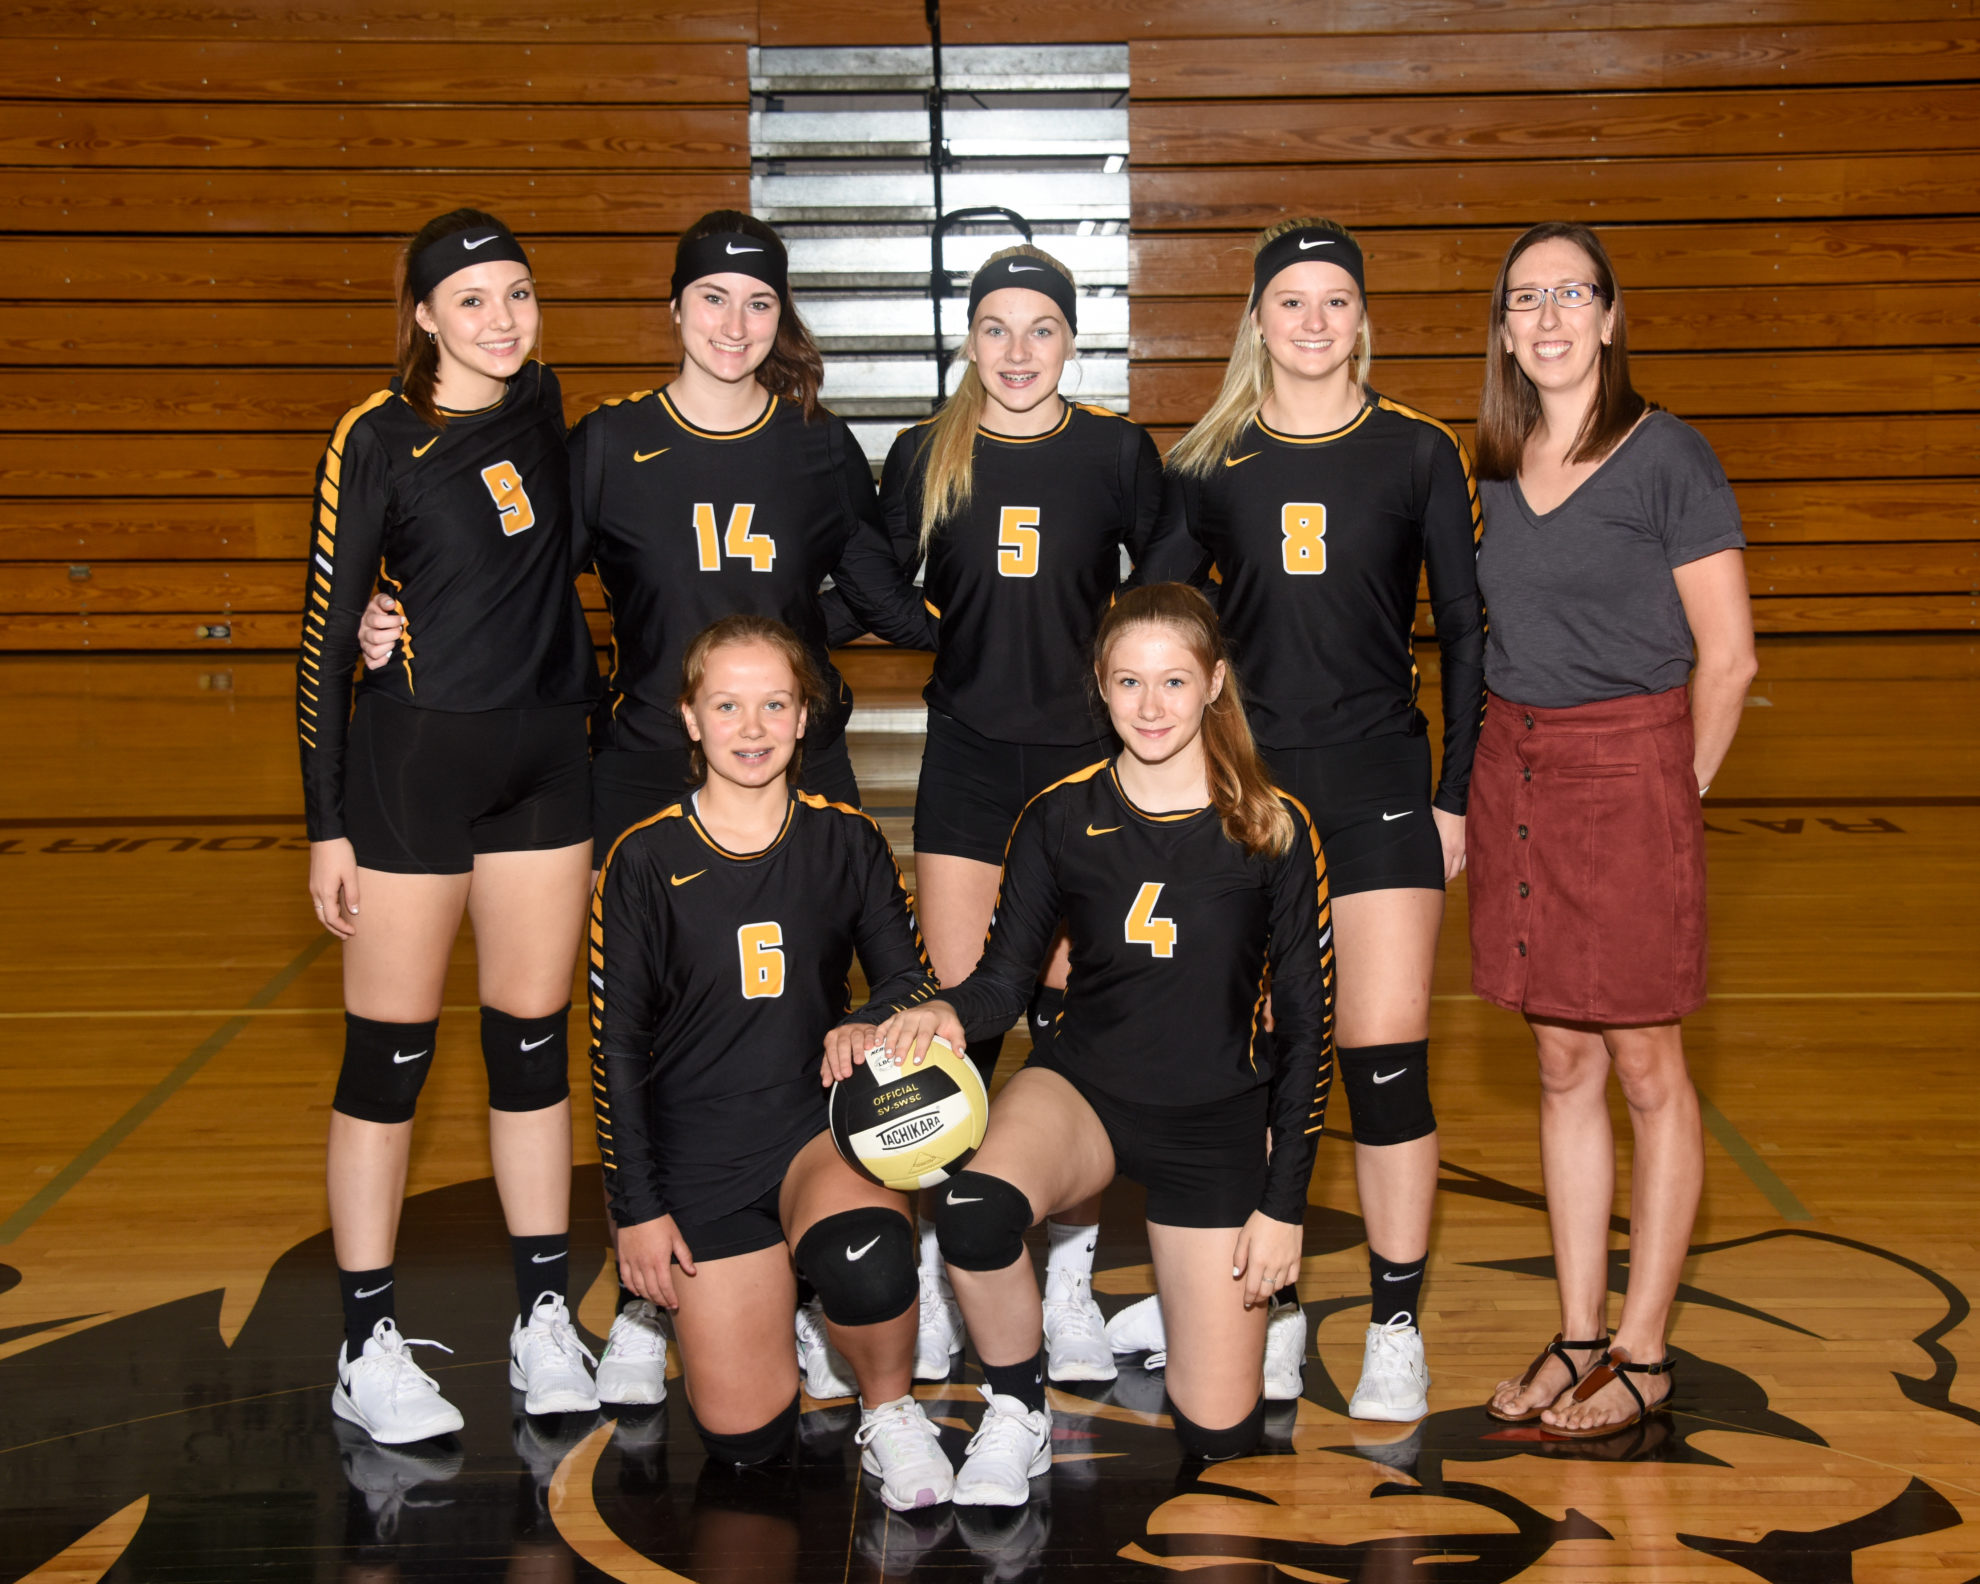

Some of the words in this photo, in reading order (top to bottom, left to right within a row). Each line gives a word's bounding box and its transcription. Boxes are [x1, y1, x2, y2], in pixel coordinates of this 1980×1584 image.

[480, 460, 536, 537] 9
[692, 503, 777, 573] 14
[998, 506, 1041, 578] 5
[1281, 502, 1327, 575] 8
[1124, 882, 1178, 959] 4
[737, 921, 786, 1000] 6
[873, 1083, 919, 1106] OFFICIAL
[876, 1111, 941, 1146] TACHIKARA
